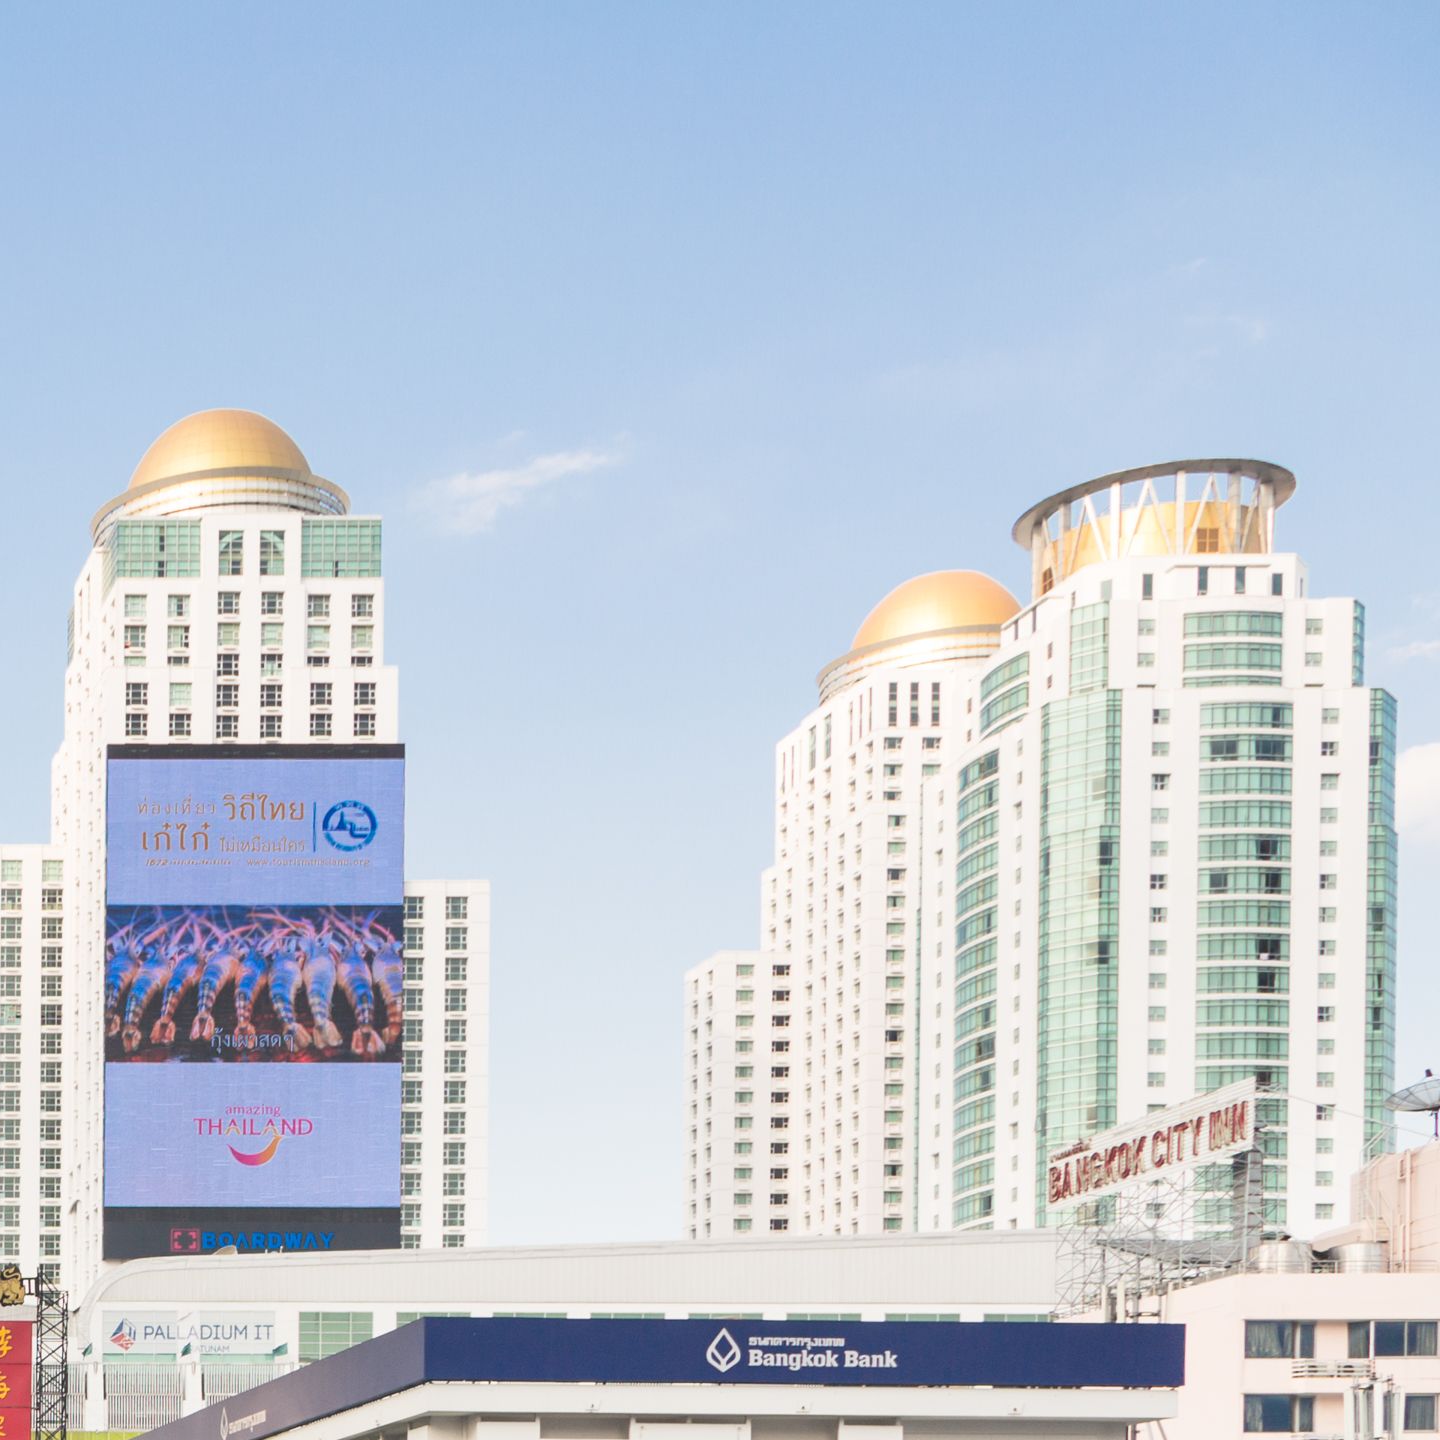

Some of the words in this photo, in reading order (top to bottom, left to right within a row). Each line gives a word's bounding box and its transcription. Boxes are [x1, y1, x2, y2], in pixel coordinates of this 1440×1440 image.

[136, 795, 216, 815] ท่องเที่ยว
[223, 793, 304, 821] วิถีไทย
[141, 822, 211, 850] เก๋ไก๋
[210, 1027, 294, 1053] กุ้งเผาสดๆ
[225, 1104, 281, 1117] amazing
[193, 1118, 314, 1136] THAILAND
[1048, 1136, 1147, 1204] BANGKOK
[1152, 1116, 1203, 1168] CITY
[1209, 1101, 1249, 1150] INN
[201, 1232, 335, 1250] BOARDWAY
[143, 1324, 248, 1341] PALLADIUM
[254, 1324, 274, 1341] IT
[748, 1349, 838, 1371] Bangkok
[843, 1350, 897, 1368] Bank
